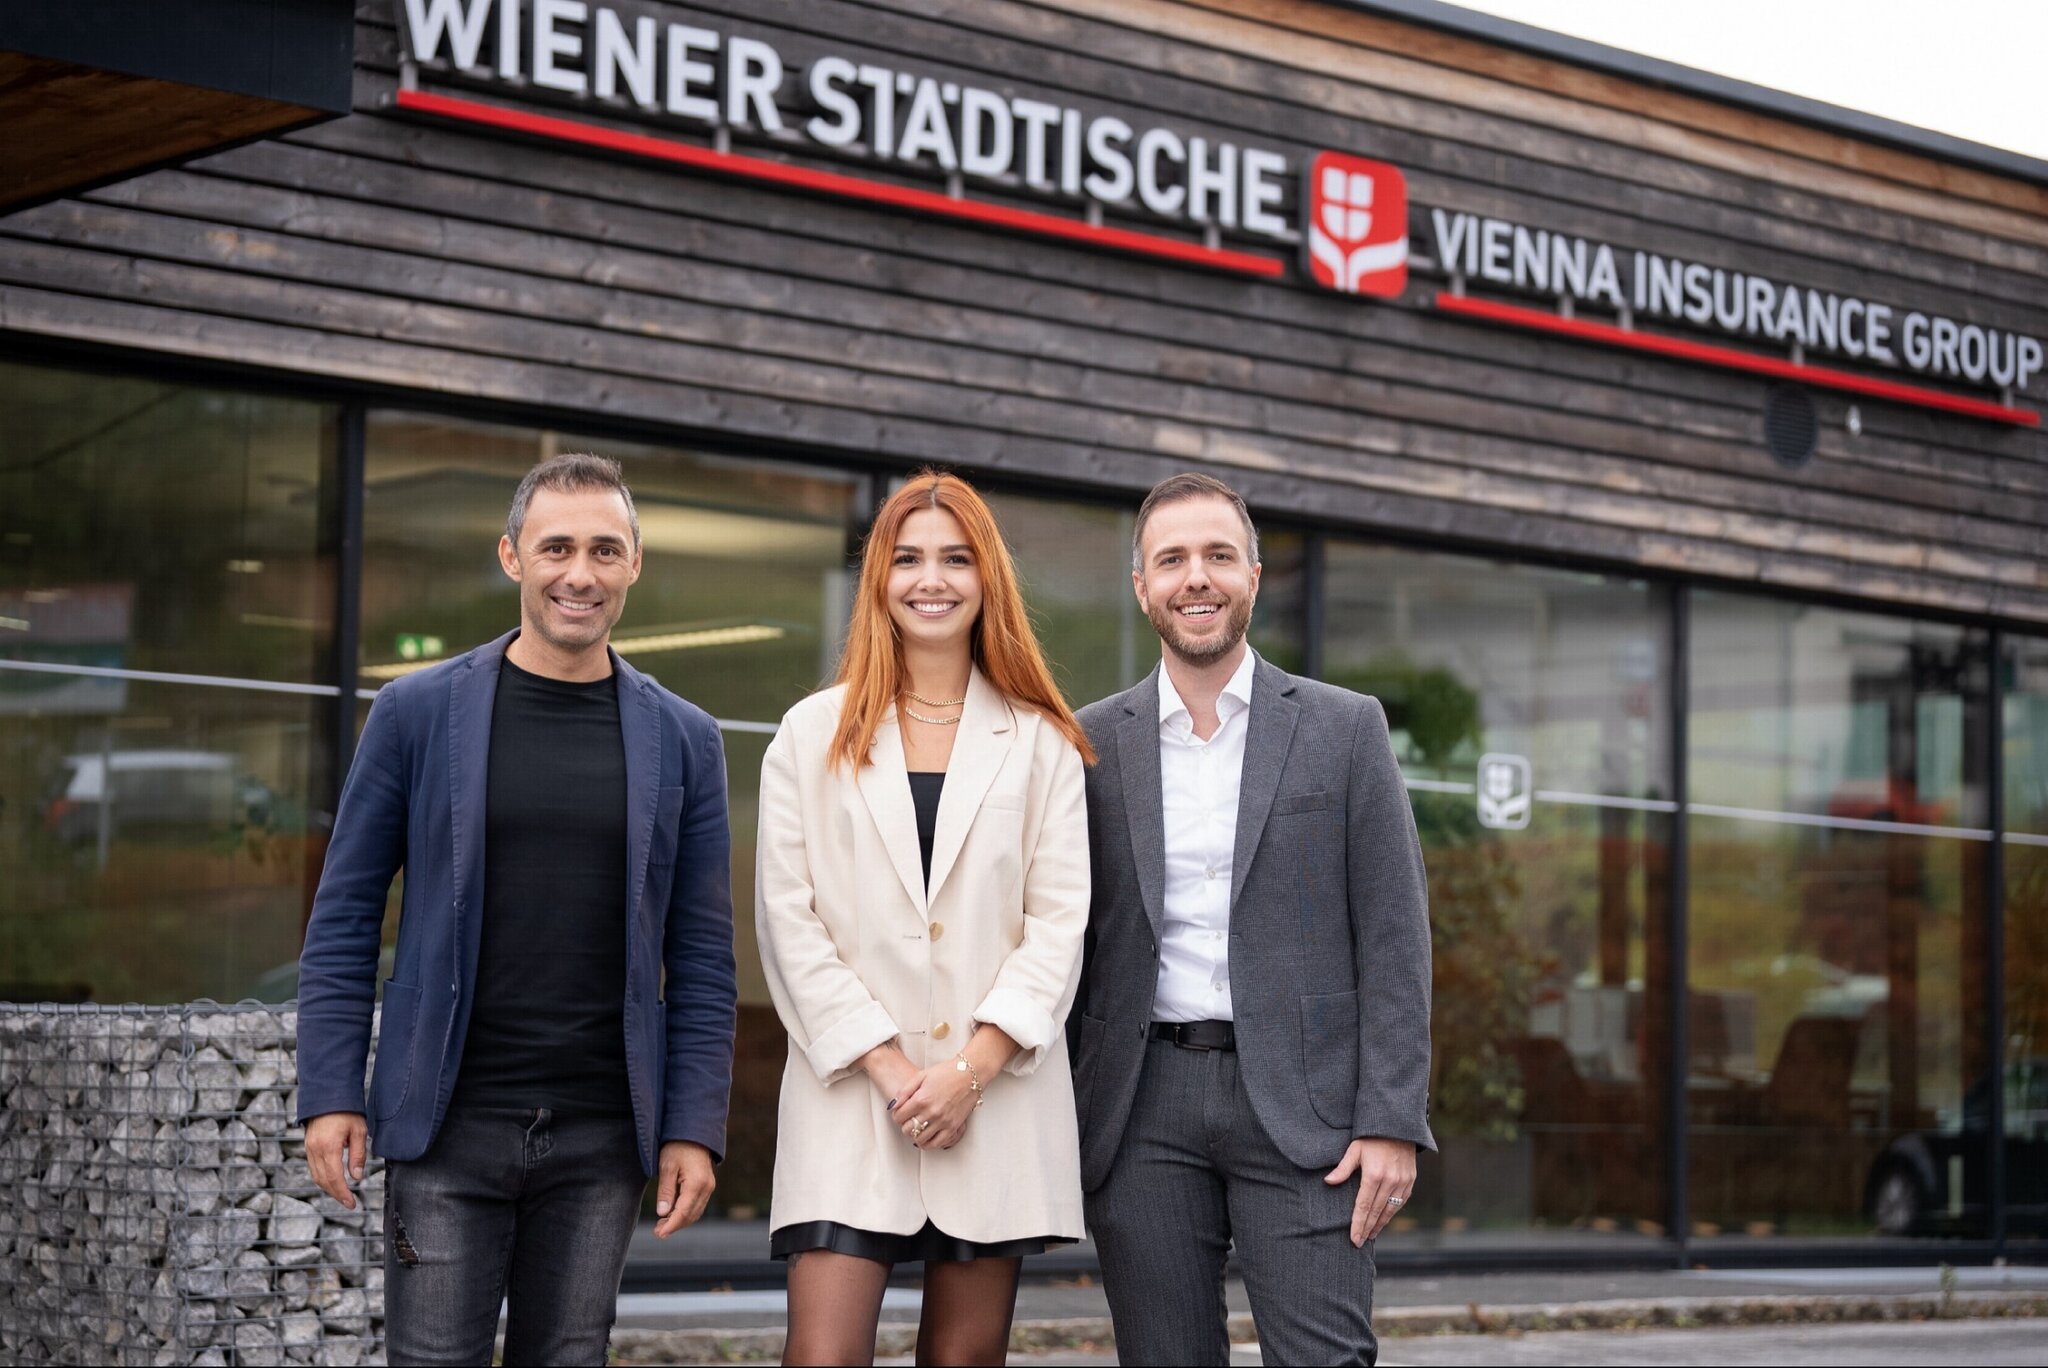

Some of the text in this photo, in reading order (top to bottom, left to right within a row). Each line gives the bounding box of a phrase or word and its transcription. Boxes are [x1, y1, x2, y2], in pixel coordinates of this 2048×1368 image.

[405, 0, 1288, 235] WIENER STÄDTISCHE
[1432, 208, 2043, 389] VIENNA INSURANCE GROUP
